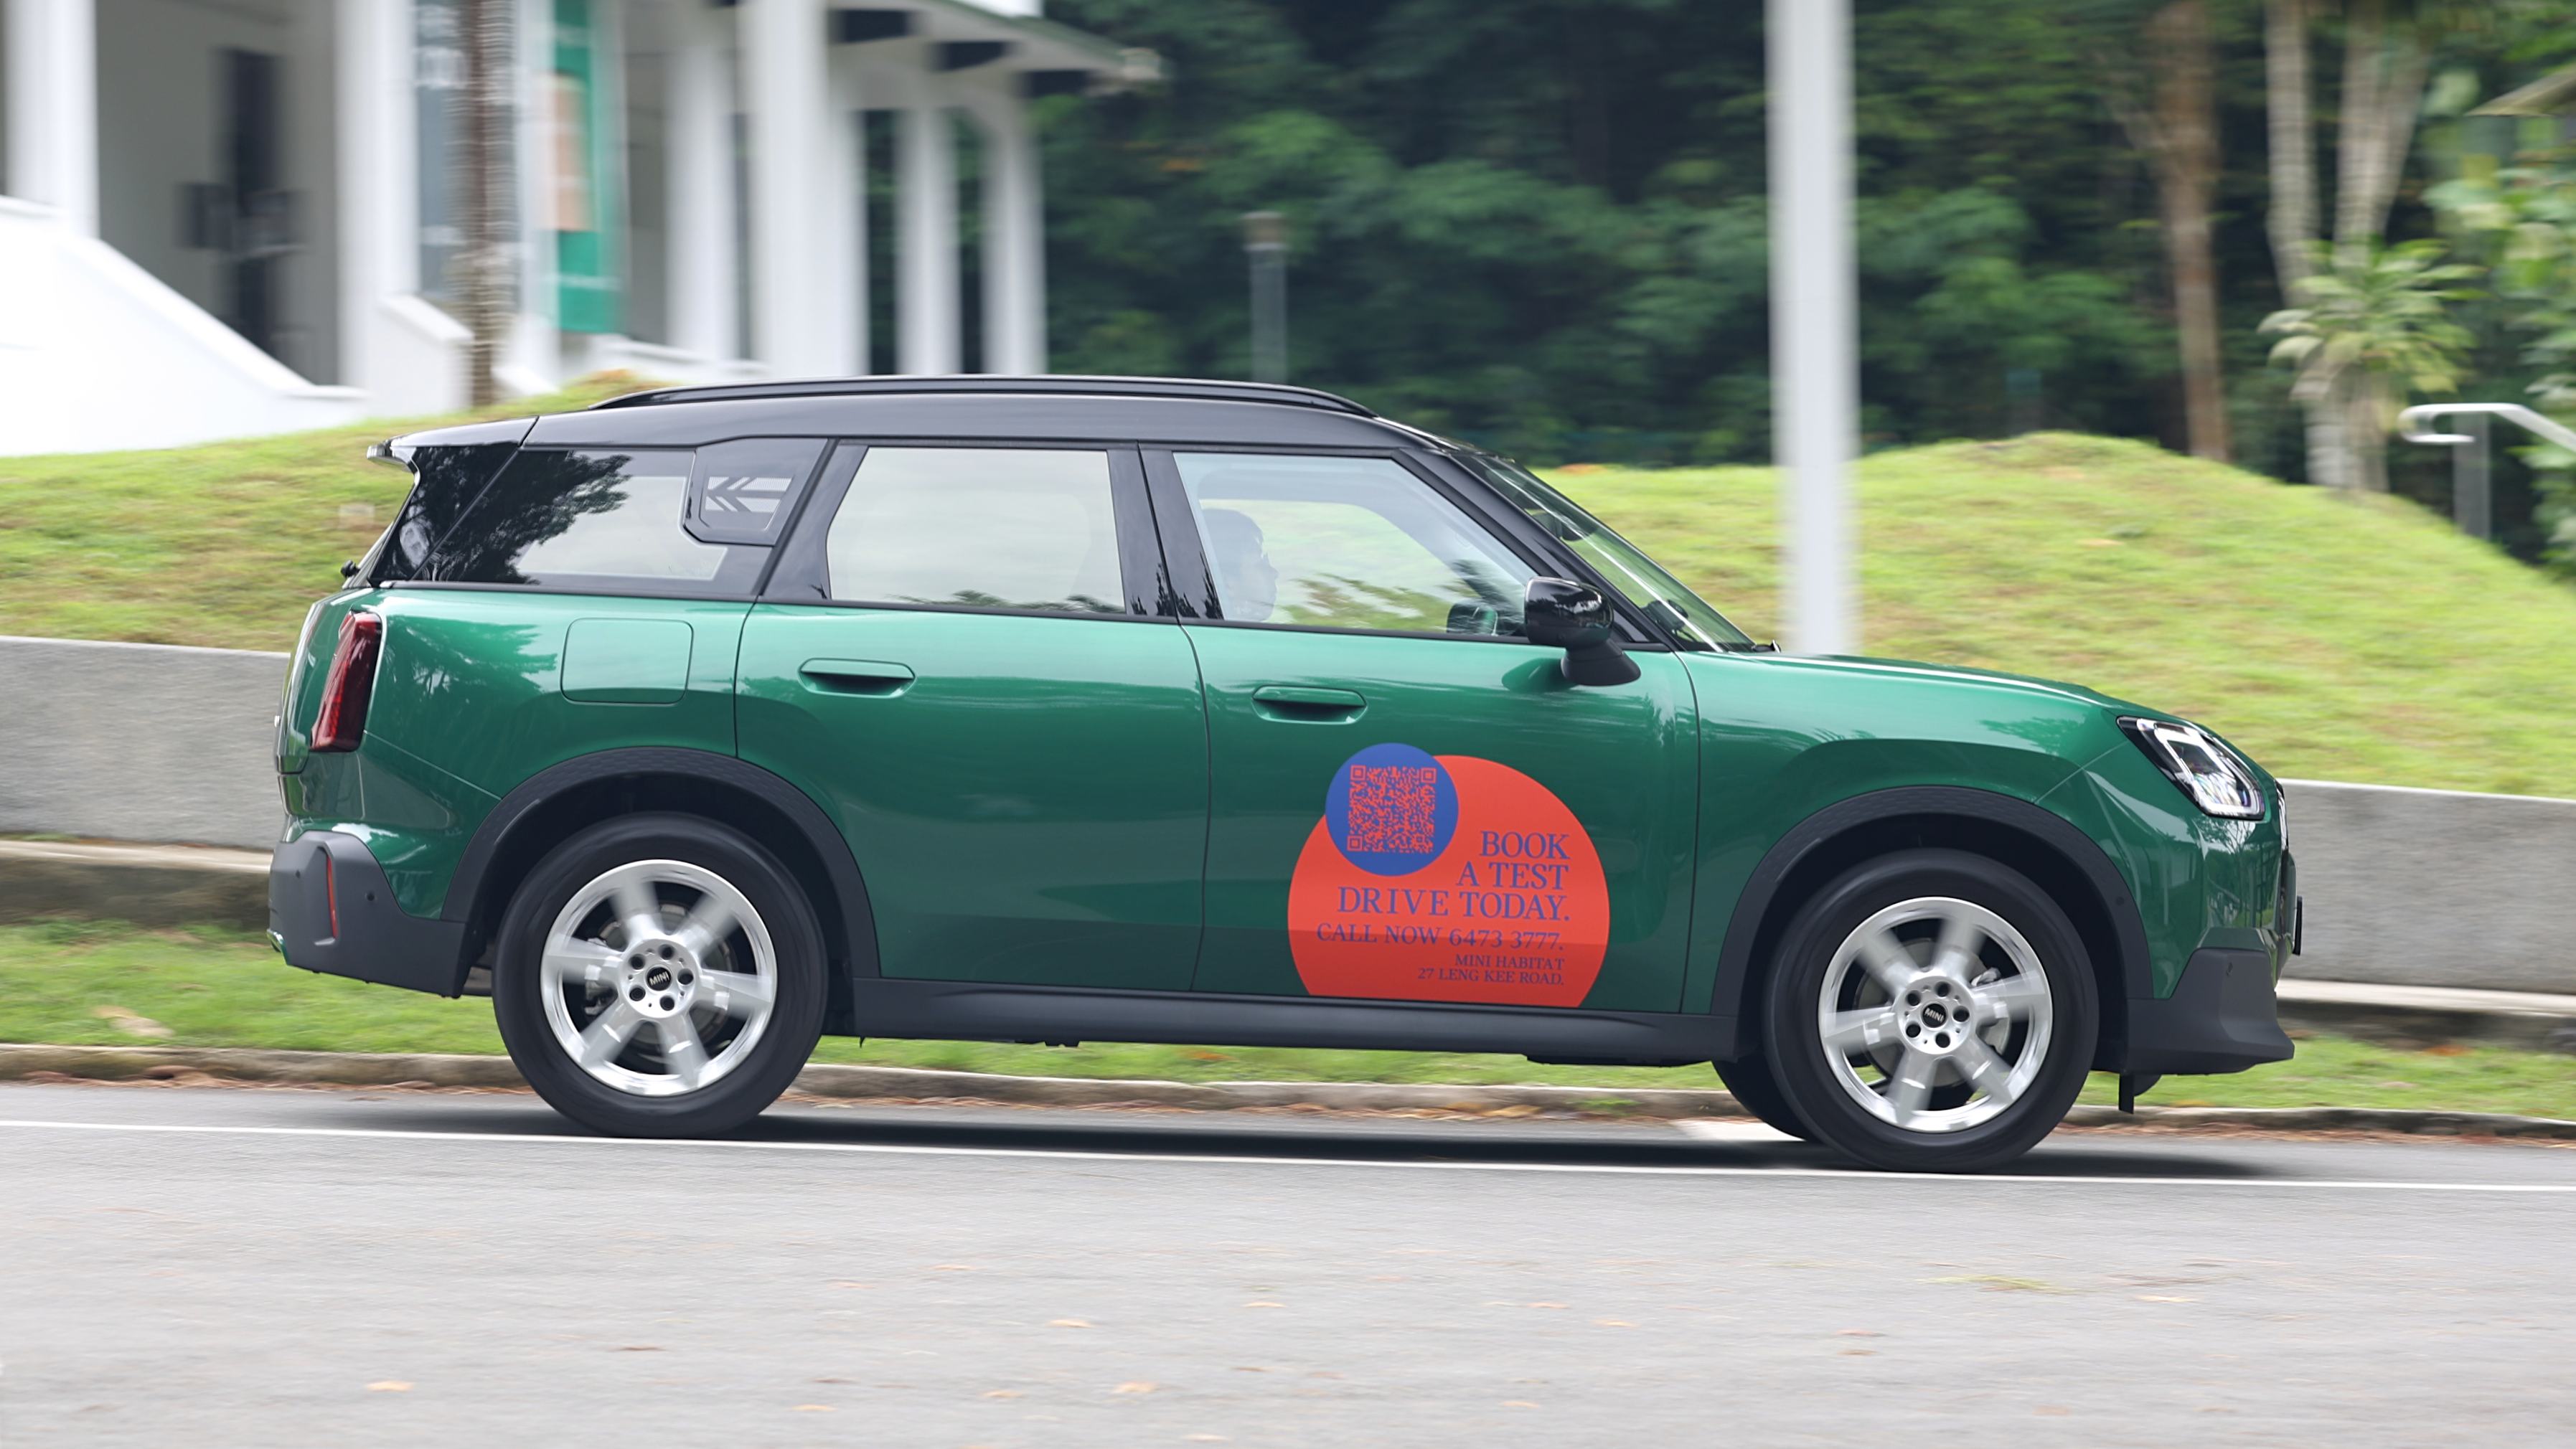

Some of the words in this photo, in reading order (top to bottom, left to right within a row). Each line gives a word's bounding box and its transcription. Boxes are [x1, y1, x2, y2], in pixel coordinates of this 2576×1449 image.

[1480, 830, 1570, 859] BOOK
[1456, 861, 1480, 887] A
[1488, 862, 1569, 889] TEST
[1337, 886, 1449, 916] DRIVE
[1459, 892, 1571, 921] TODAY.
[1317, 922, 1378, 943] CALL
[1384, 925, 1442, 945] NOW
[1449, 928, 1503, 948] 6473
[1510, 931, 1564, 950] 3777.
[1455, 954, 1491, 968] MINI
[1495, 955, 1565, 971] HABITAT
[649, 971, 669, 985] MINI
[1418, 968, 1434, 980] 27
[1438, 968, 1480, 982] LENG
[1484, 971, 1515, 983] KEE
[1520, 972, 1564, 986] ROAD.
[1924, 1007, 1944, 1021] MINI
